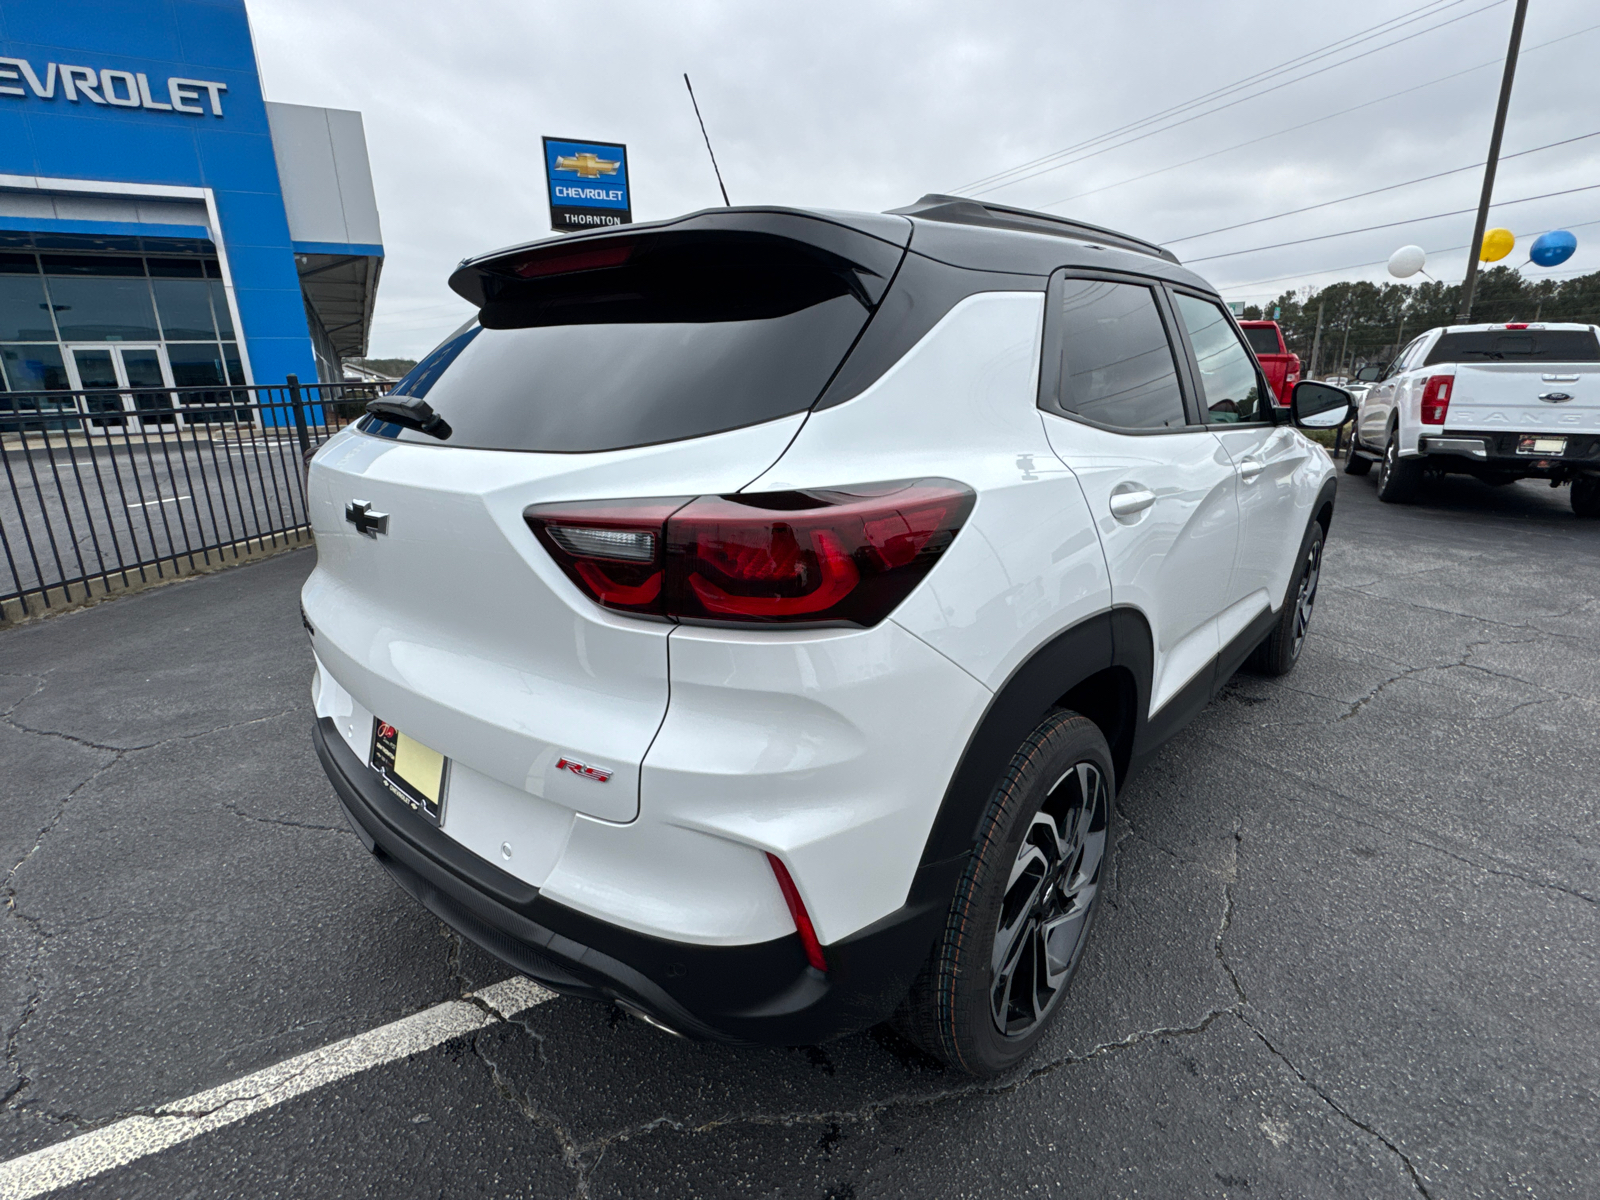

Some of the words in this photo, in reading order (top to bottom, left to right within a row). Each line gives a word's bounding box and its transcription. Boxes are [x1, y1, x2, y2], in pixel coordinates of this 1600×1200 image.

[555, 186, 623, 201] CHEVROLET
[564, 213, 621, 226] THORNTON
[1452, 411, 1600, 426] RANG
[555, 756, 613, 783] RS
